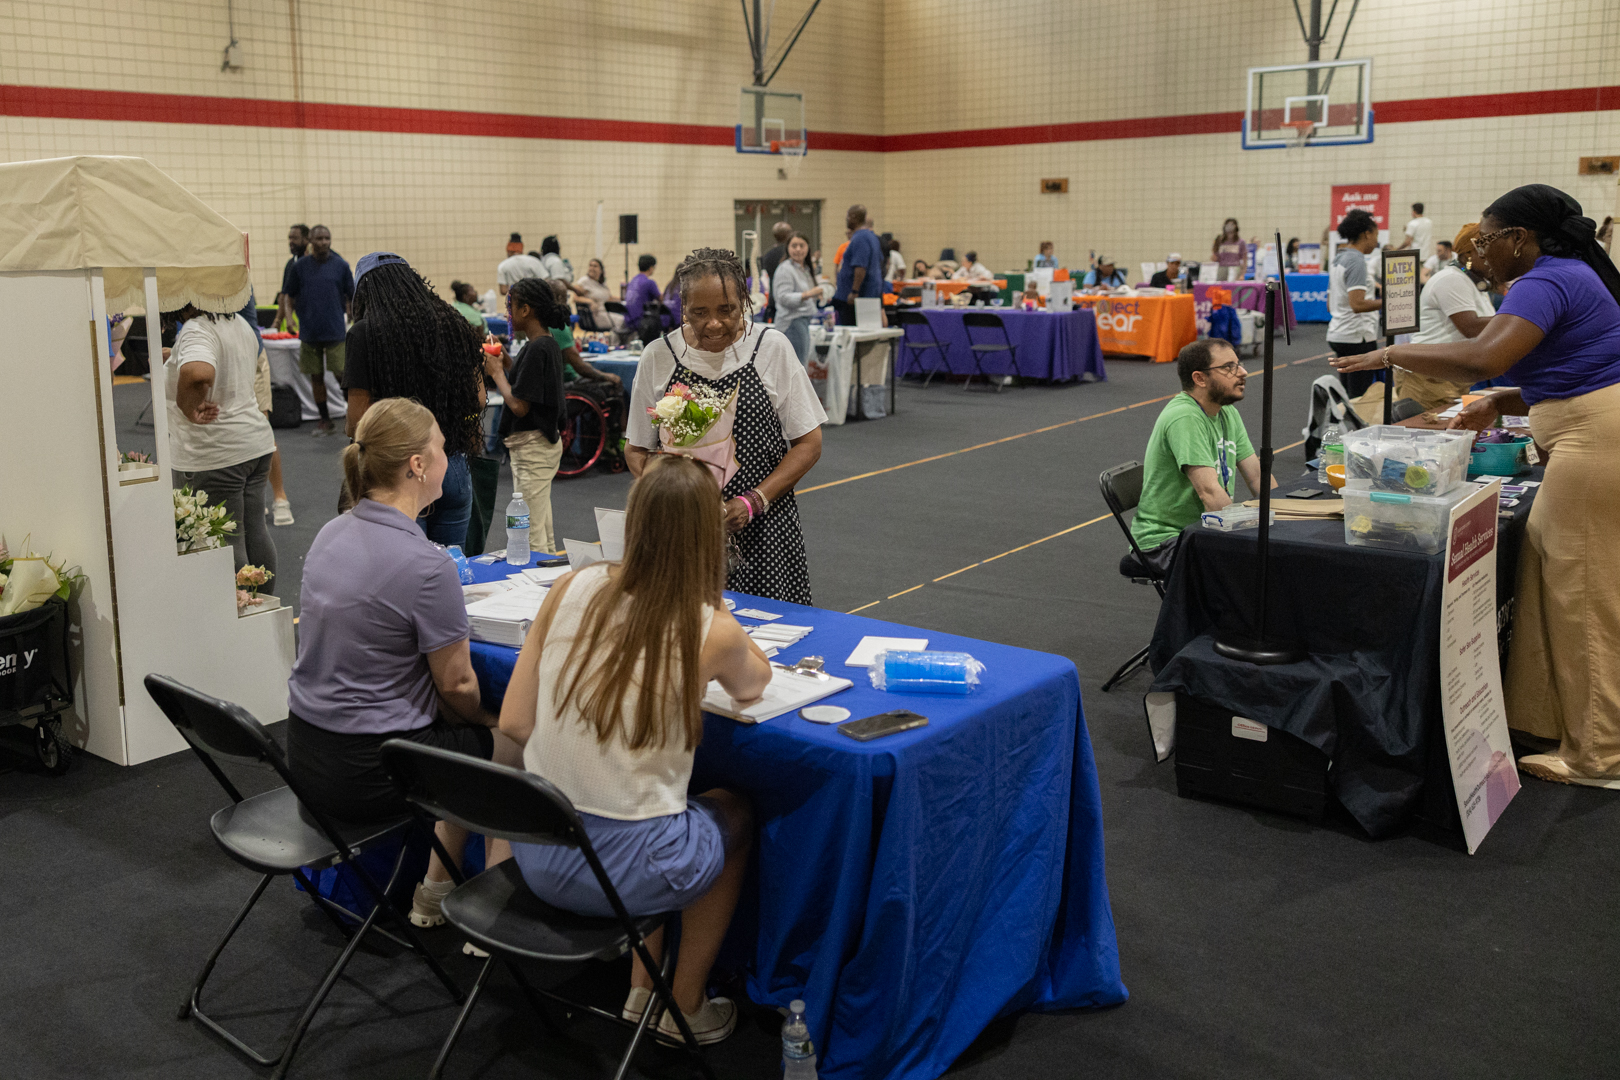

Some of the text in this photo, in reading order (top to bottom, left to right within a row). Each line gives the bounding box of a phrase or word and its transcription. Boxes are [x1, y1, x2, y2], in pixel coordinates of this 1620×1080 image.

[1342, 192, 1379, 202] Ask me
[1387, 262, 1413, 275] LATEX
[1386, 276, 1414, 286] ALLERGY?
[1386, 289, 1414, 299] Non-Latex
[1388, 302, 1413, 312] Condoms
[1096, 313, 1142, 332] ear
[1388, 314, 1412, 324] Available
[1464, 534, 1477, 556] Health
[1477, 527, 1494, 547] Services
